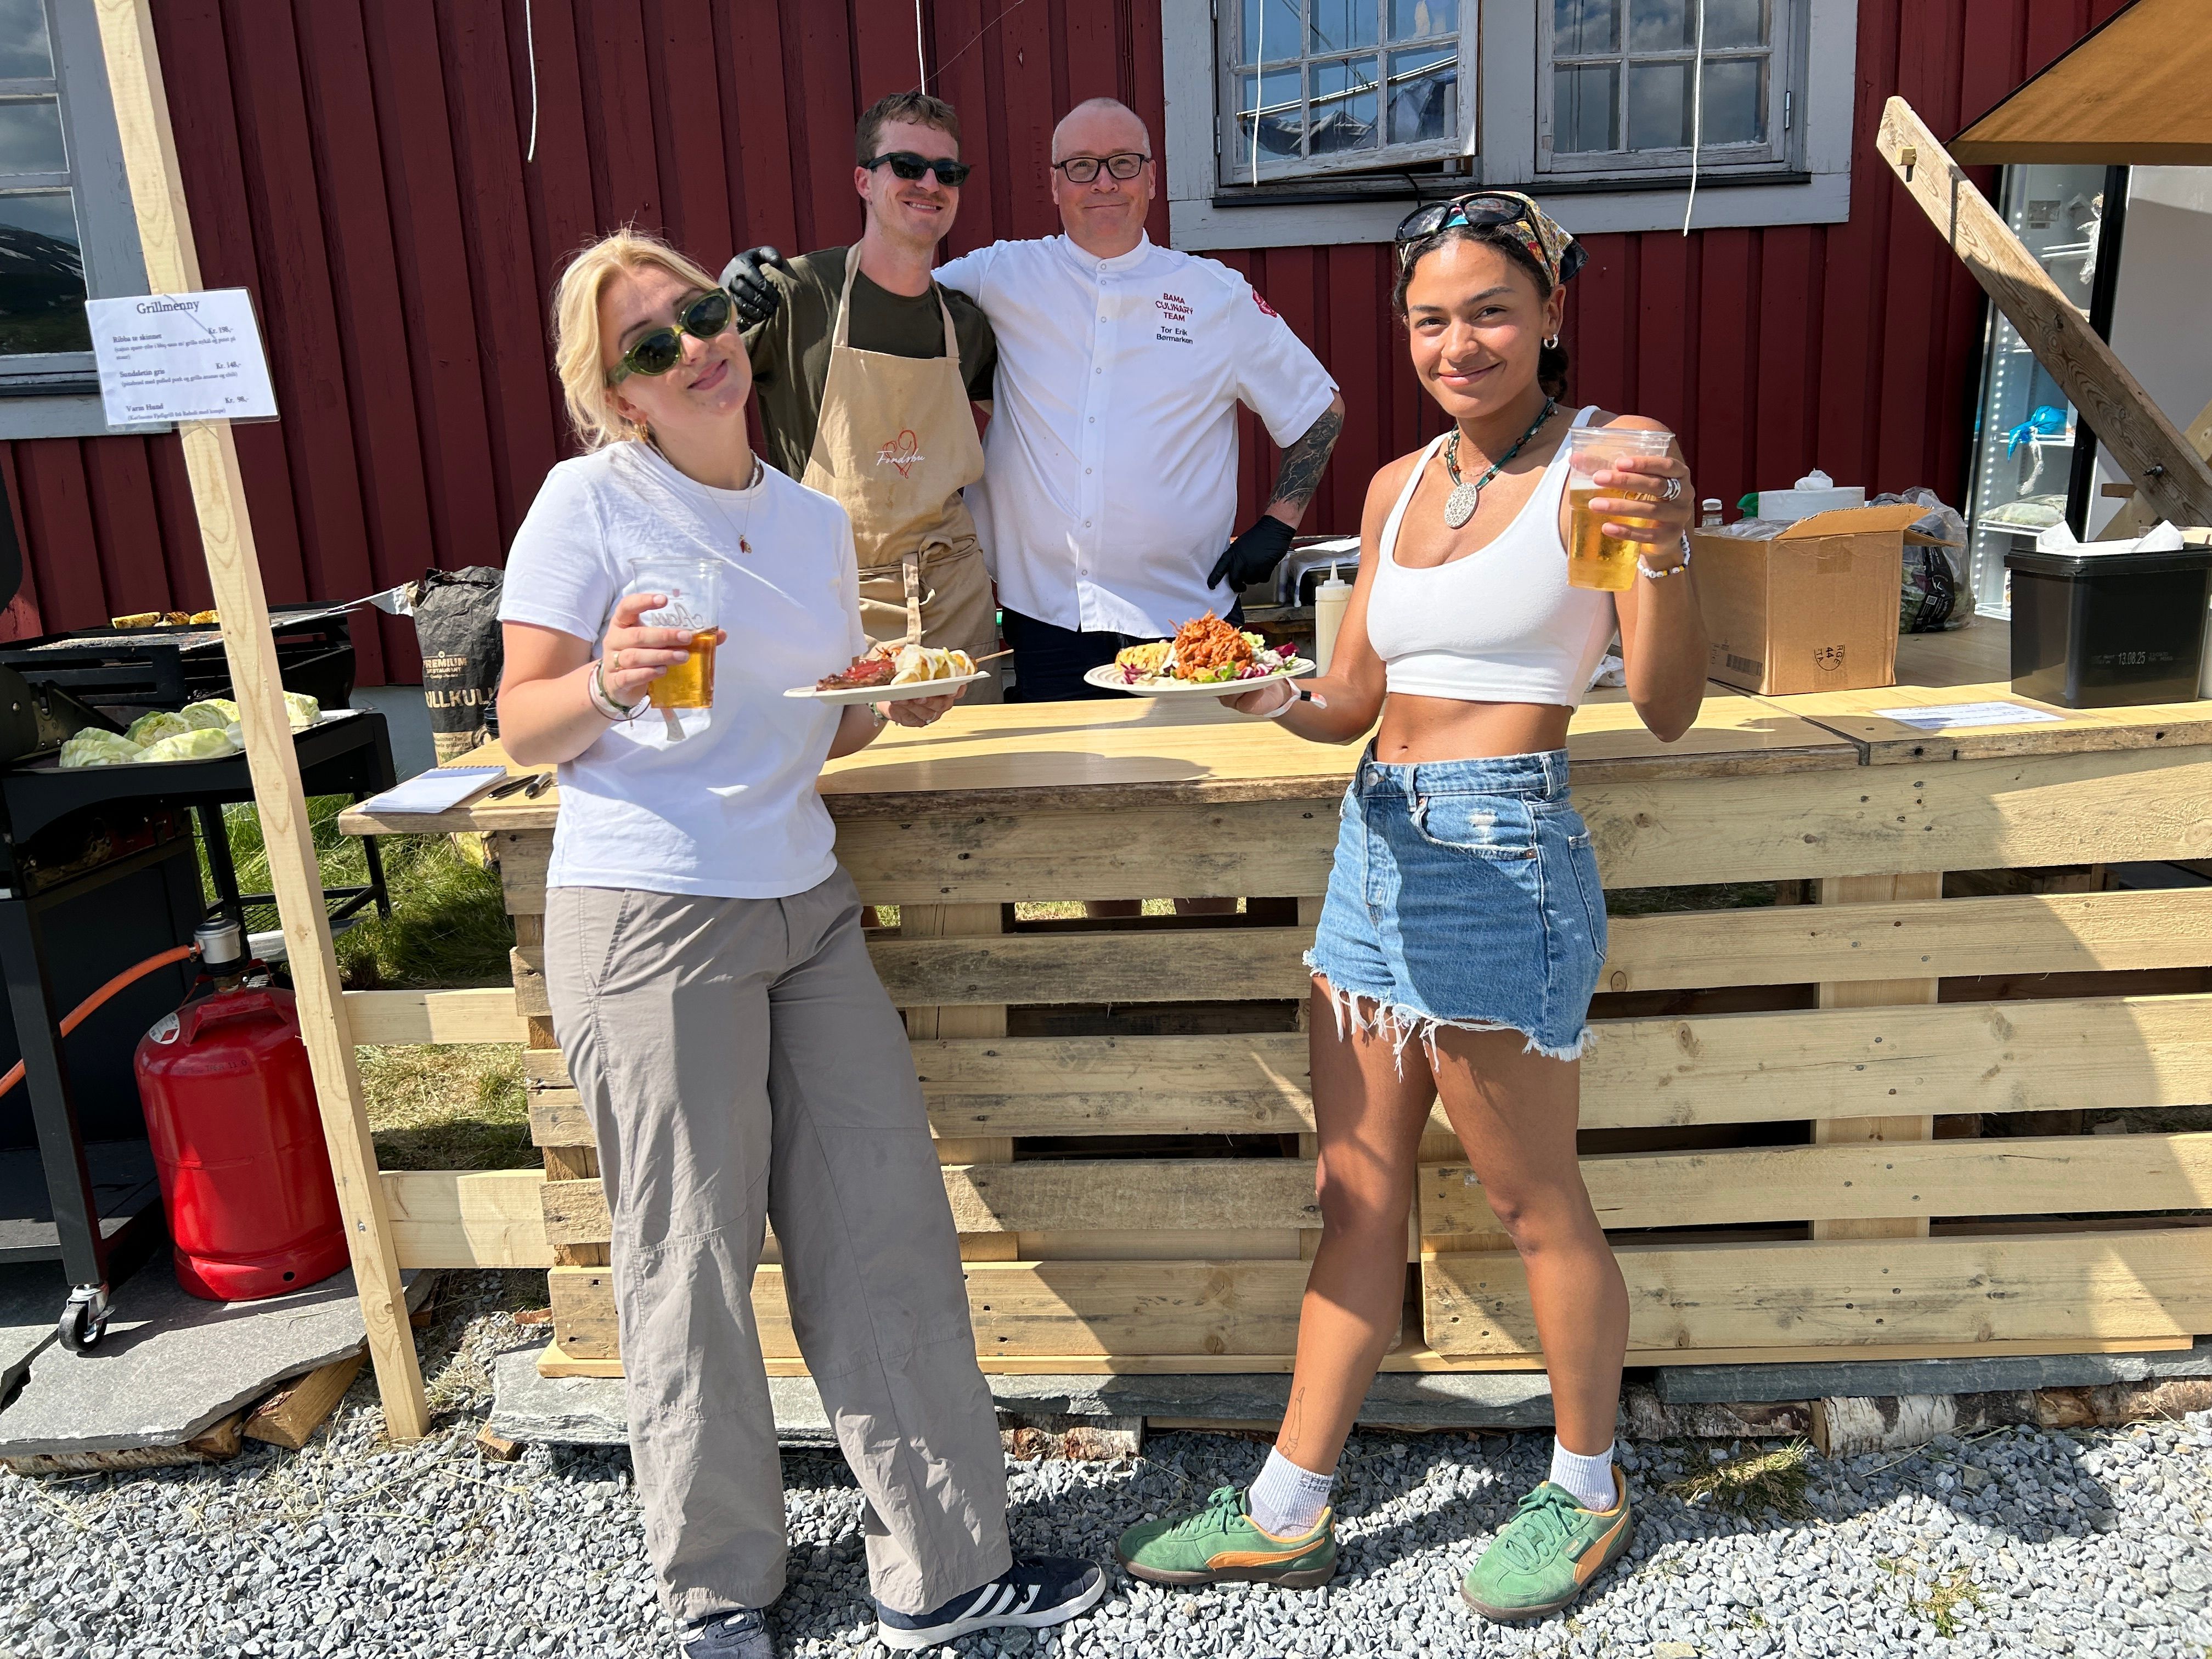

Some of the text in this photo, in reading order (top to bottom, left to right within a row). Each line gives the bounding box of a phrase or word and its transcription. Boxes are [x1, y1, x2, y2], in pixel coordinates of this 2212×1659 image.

[1163, 292, 1186, 305] BAMA
[137, 301, 200, 314] Grillmenny
[1155, 301, 1193, 315] CULINARY
[1163, 312, 1186, 322] TEAM
[1826, 647, 1834, 658] 44
[2118, 651, 2146, 665] 13.08.25
